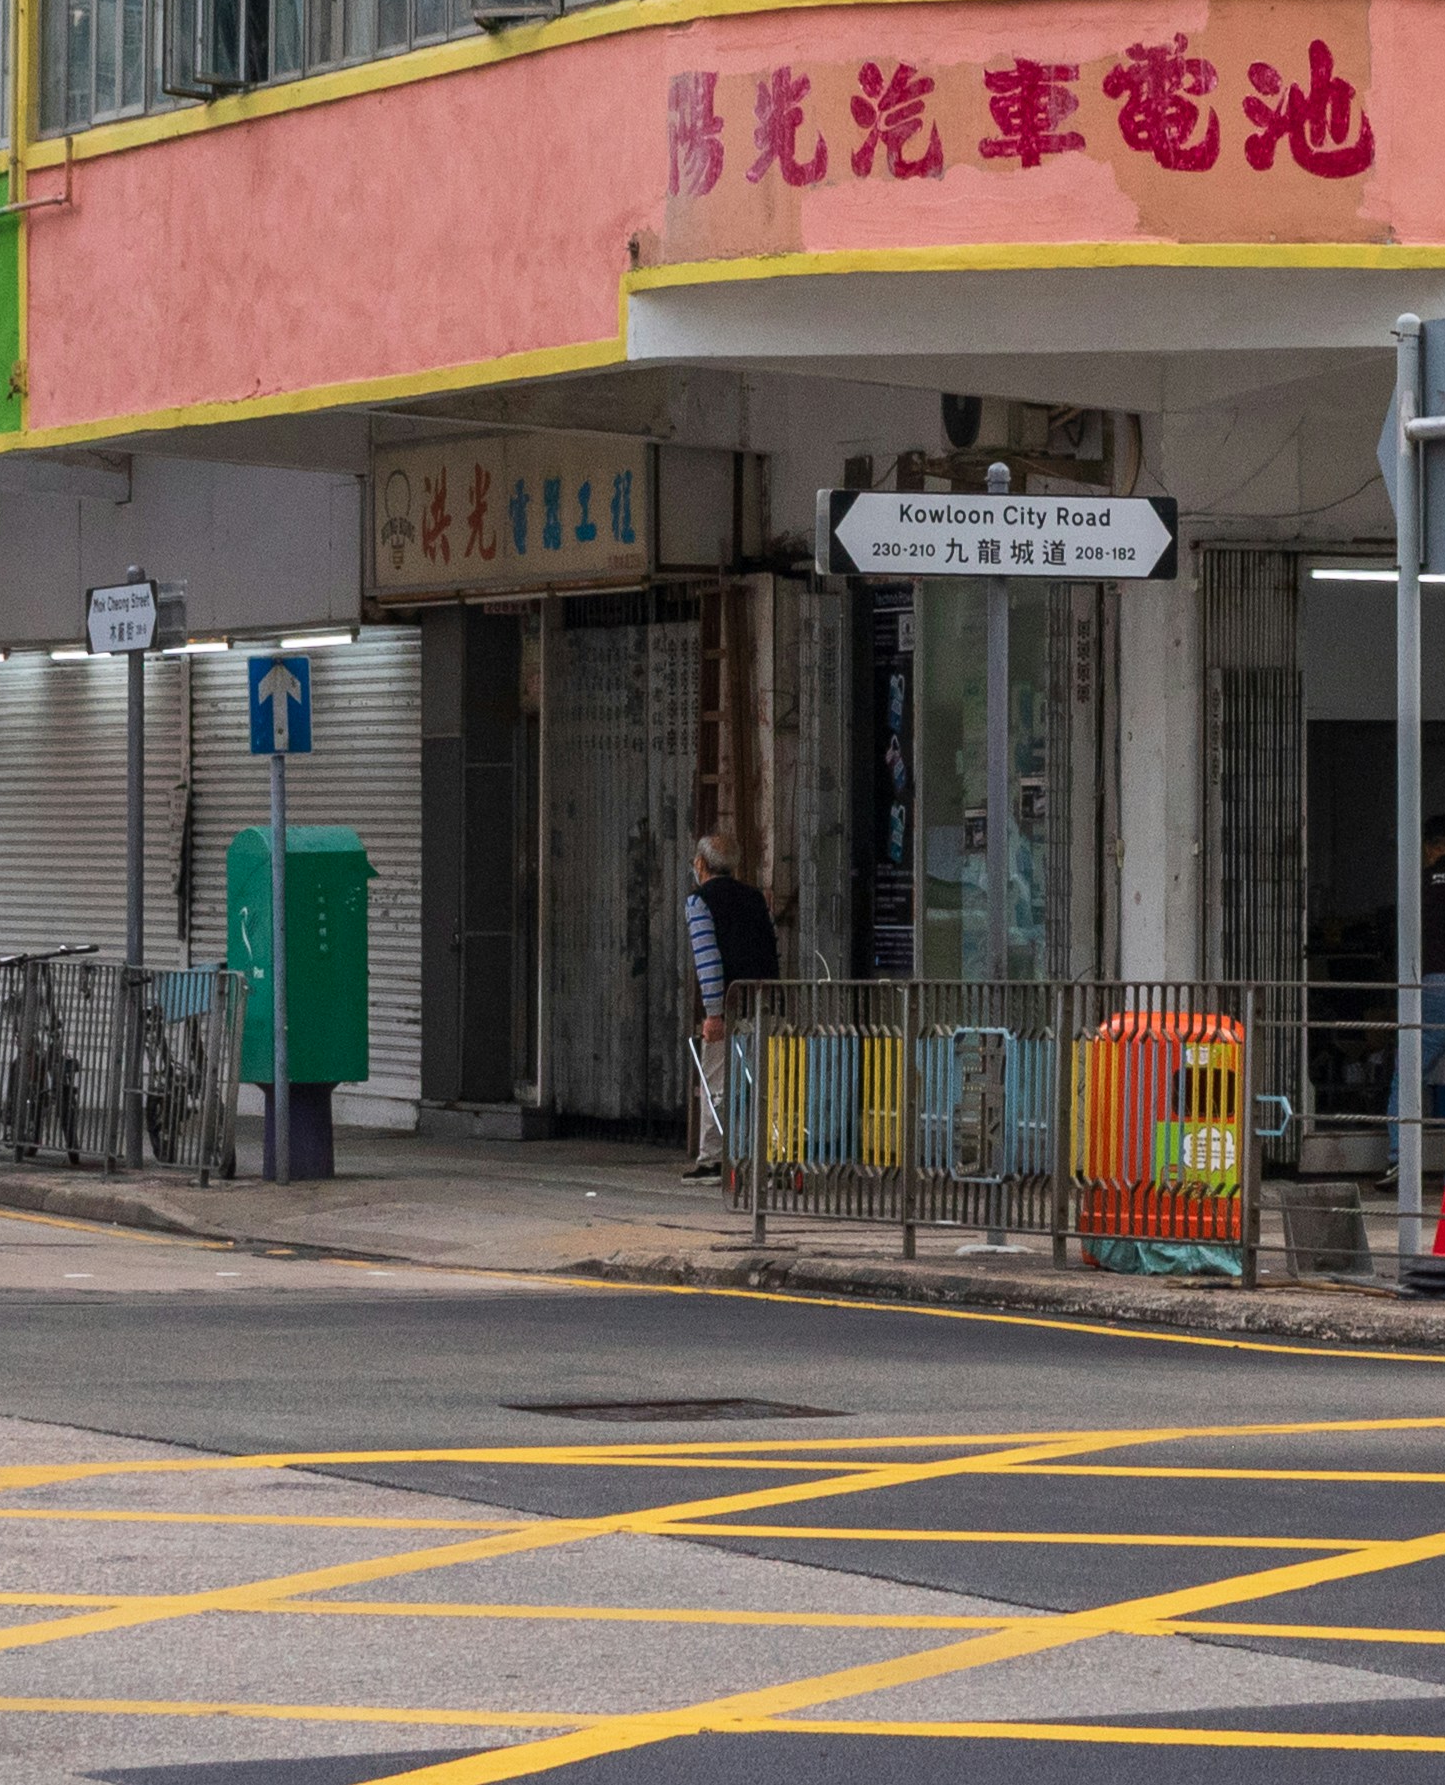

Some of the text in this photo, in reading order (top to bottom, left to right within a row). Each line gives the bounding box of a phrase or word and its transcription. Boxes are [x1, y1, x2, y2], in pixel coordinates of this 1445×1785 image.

[667, 33, 1375, 197] 陽光汽車電池
[899, 503, 1112, 530] Kowloon City Road
[871, 537, 1137, 566] 230-210 九龍城道 208-182
